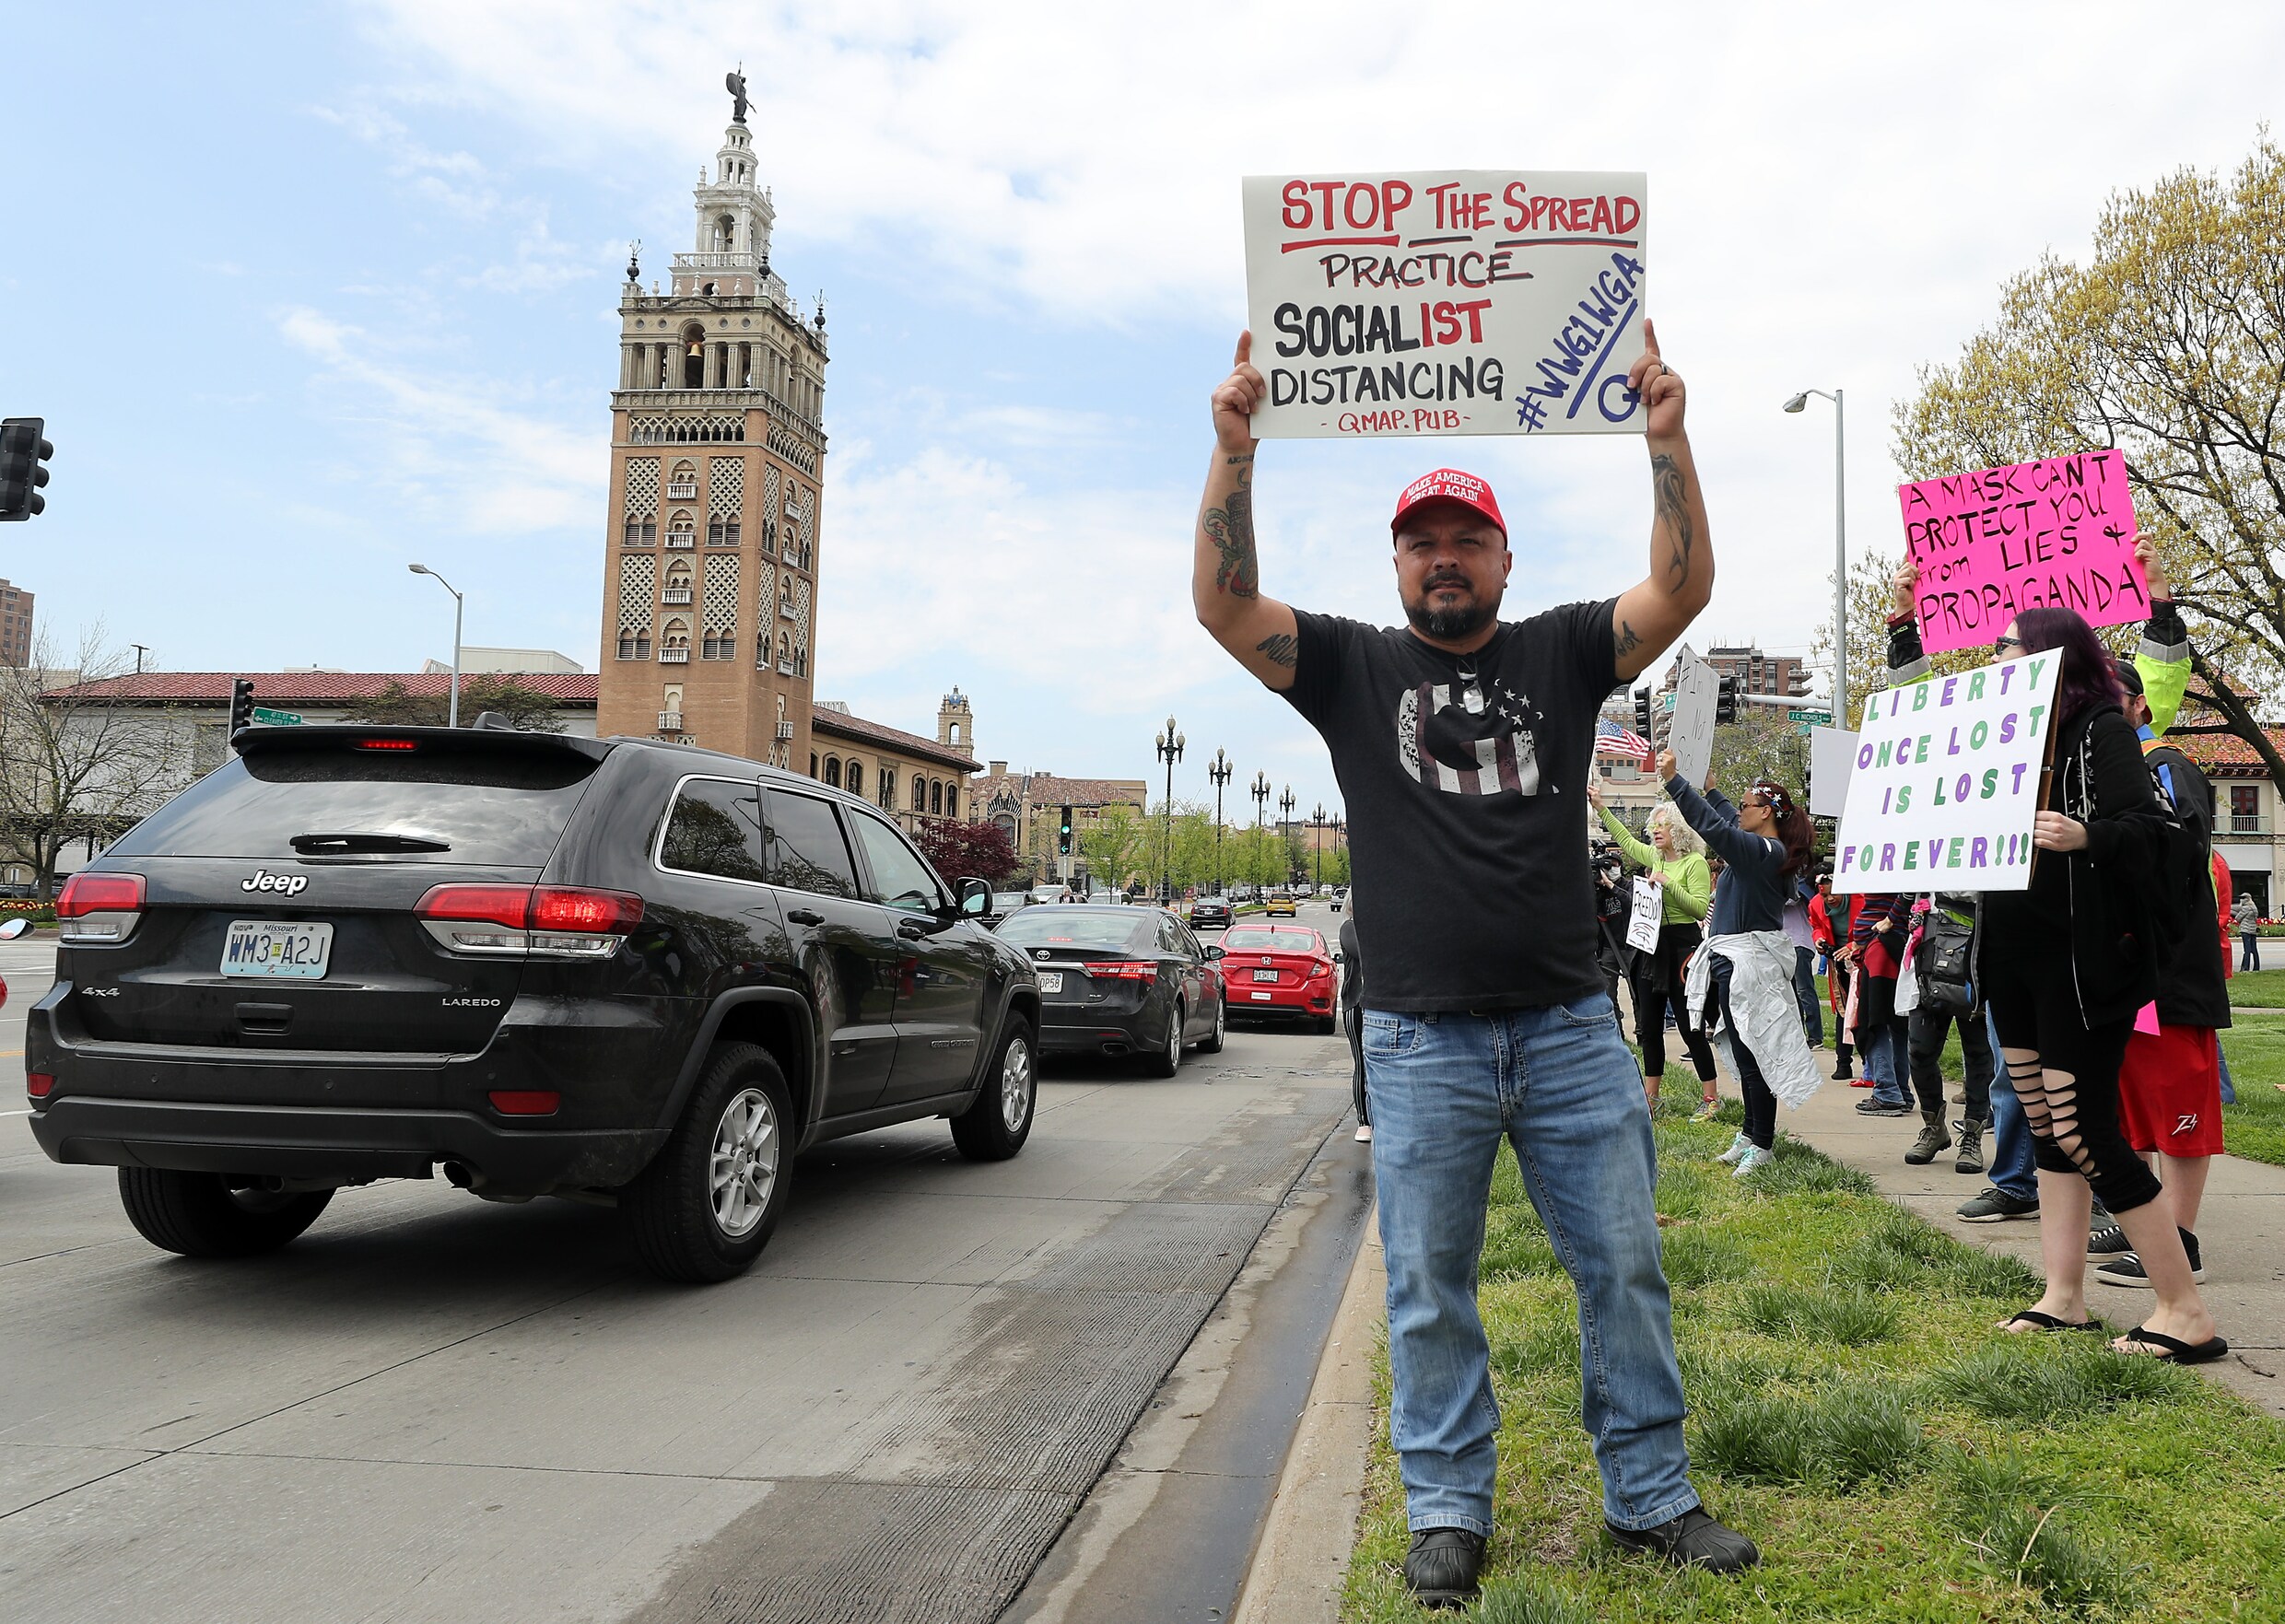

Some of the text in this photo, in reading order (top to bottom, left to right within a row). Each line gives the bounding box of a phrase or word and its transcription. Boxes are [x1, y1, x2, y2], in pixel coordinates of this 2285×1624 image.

[1282, 180, 1640, 234] STOP THE SPREAD
[1319, 251, 1533, 289] PRACTICE
[1274, 298, 1493, 357] SOCIALIST
[1271, 356, 1504, 406] DISTANCING
[1405, 472, 1484, 499] MAKE AMERICA
[1444, 485, 1479, 502] AGAIN
[1907, 455, 2110, 514] A MASK CAN'T
[1907, 485, 2108, 557] PROTECT YOU
[1999, 525, 2079, 572] LIES
[1919, 562, 2145, 639] PROPAGANDA
[1868, 658, 2046, 721] LIBERTY
[1857, 705, 2045, 770] ONCE LOST
[1881, 763, 2027, 814] IS LOST
[1841, 832, 2028, 873] FOREVER!!!
[241, 870, 309, 898] Jeep
[263, 924, 298, 932] Missouri
[81, 987, 120, 997] 4x4
[442, 998, 500, 1007] LAREDO
